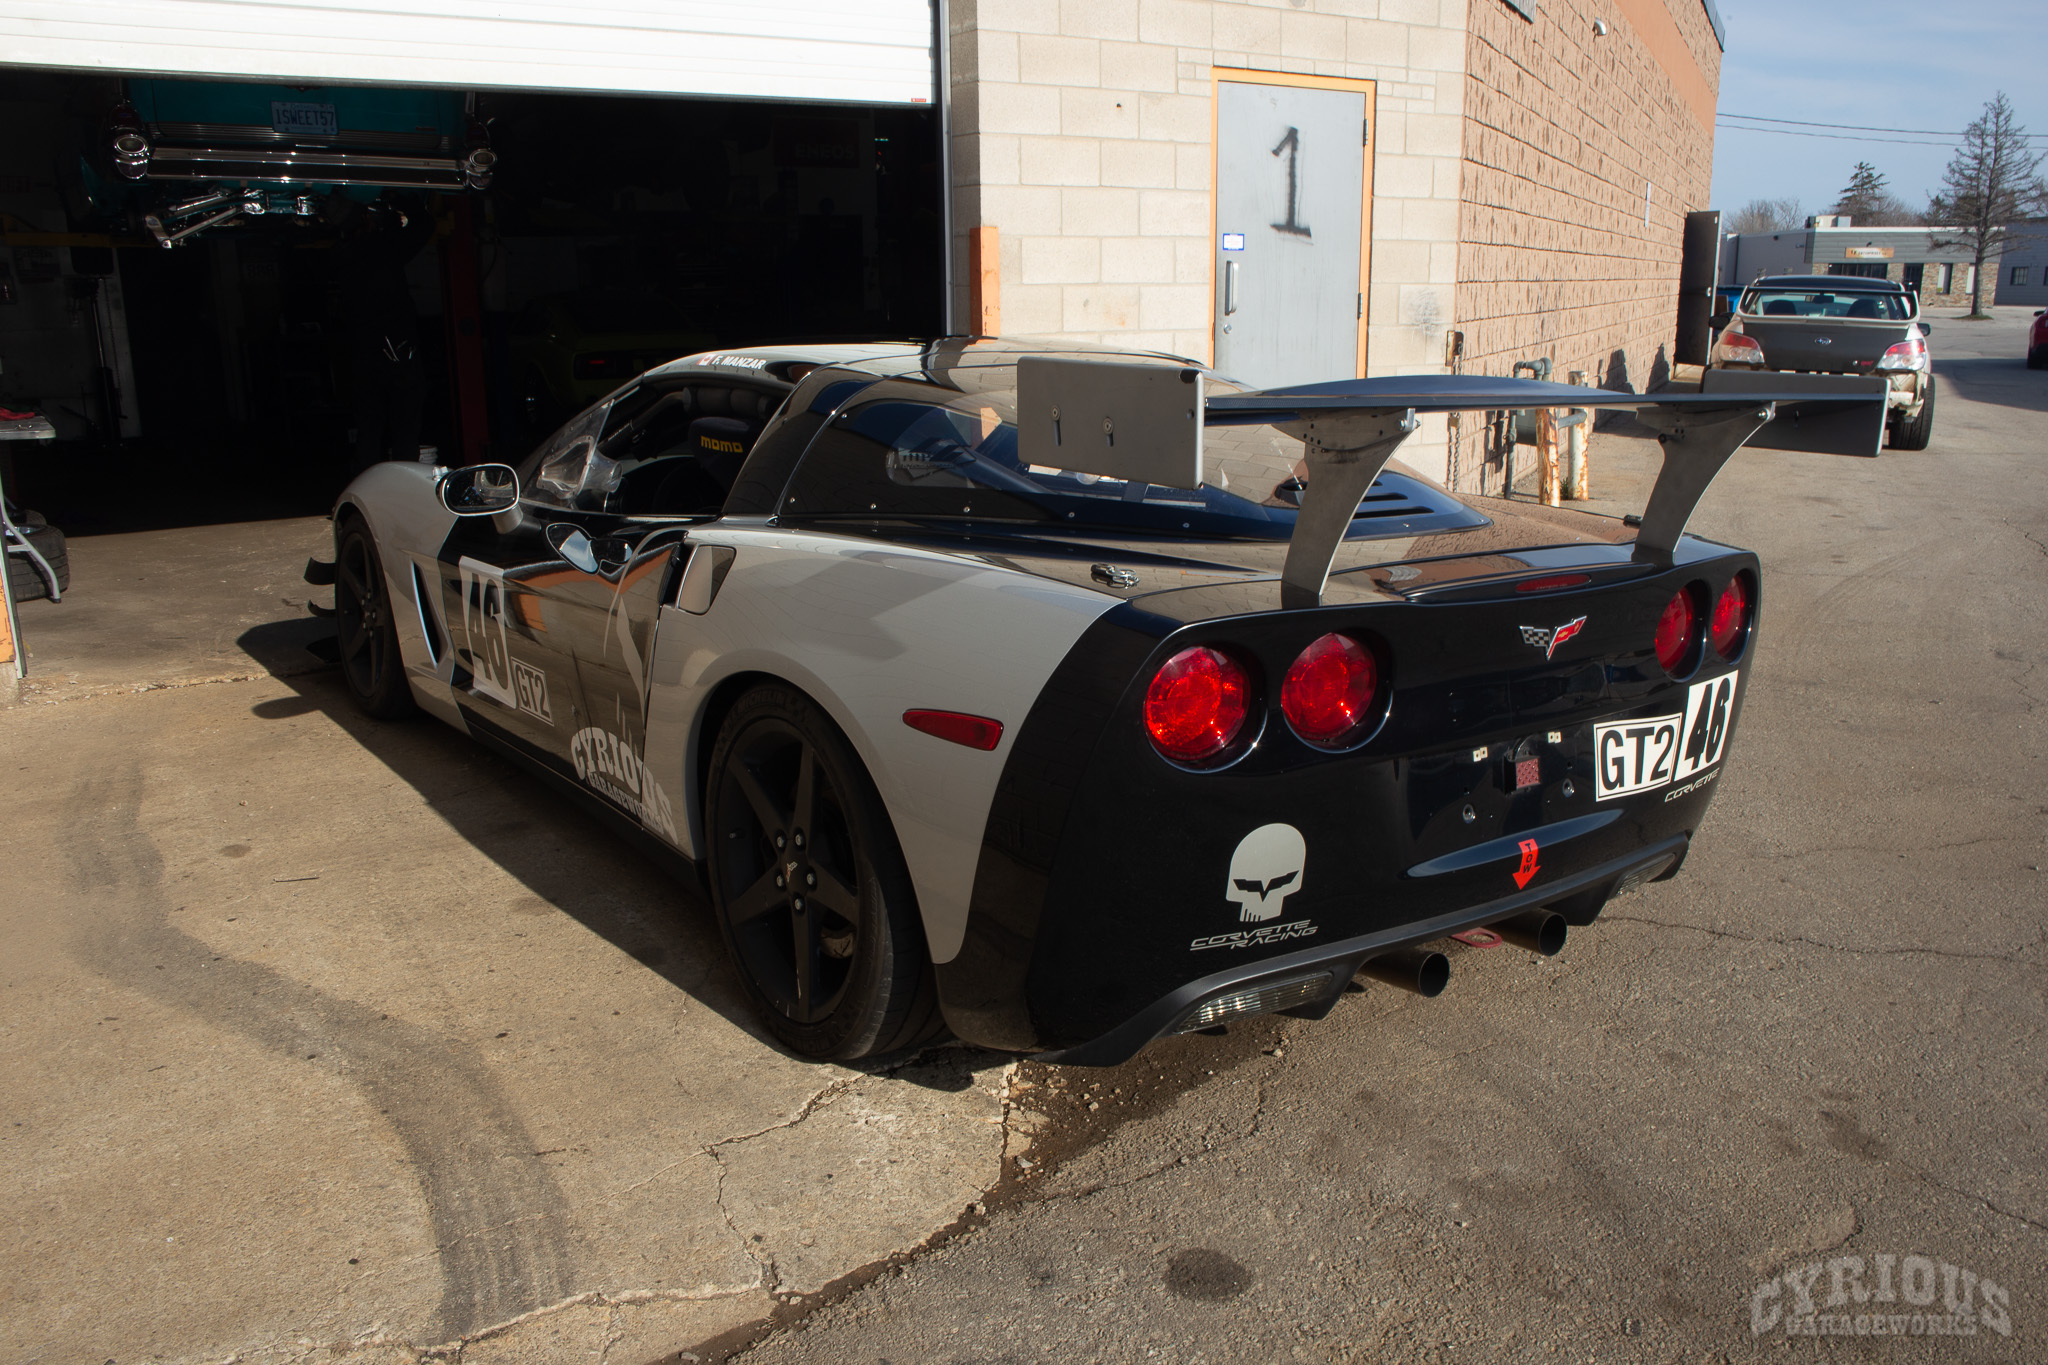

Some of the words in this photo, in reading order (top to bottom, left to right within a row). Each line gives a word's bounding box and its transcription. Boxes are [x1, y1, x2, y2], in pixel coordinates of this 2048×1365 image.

[1269, 126, 1311, 238] 1
[711, 355, 724, 365] F.
[721, 356, 767, 370] MANZAR
[468, 572, 509, 690] 46
[515, 664, 550, 718] GT2
[1684, 678, 1731, 771] 46
[570, 727, 679, 845] CYRIOUS
[1600, 724, 1674, 791] GT2
[1664, 767, 1720, 803] CORVETTE
[587, 769, 665, 835] GARAGEWORKS
[1522, 842, 1534, 874] TOW
[1190, 919, 1311, 948] CORVETTE
[1230, 926, 1318, 950] RACING
